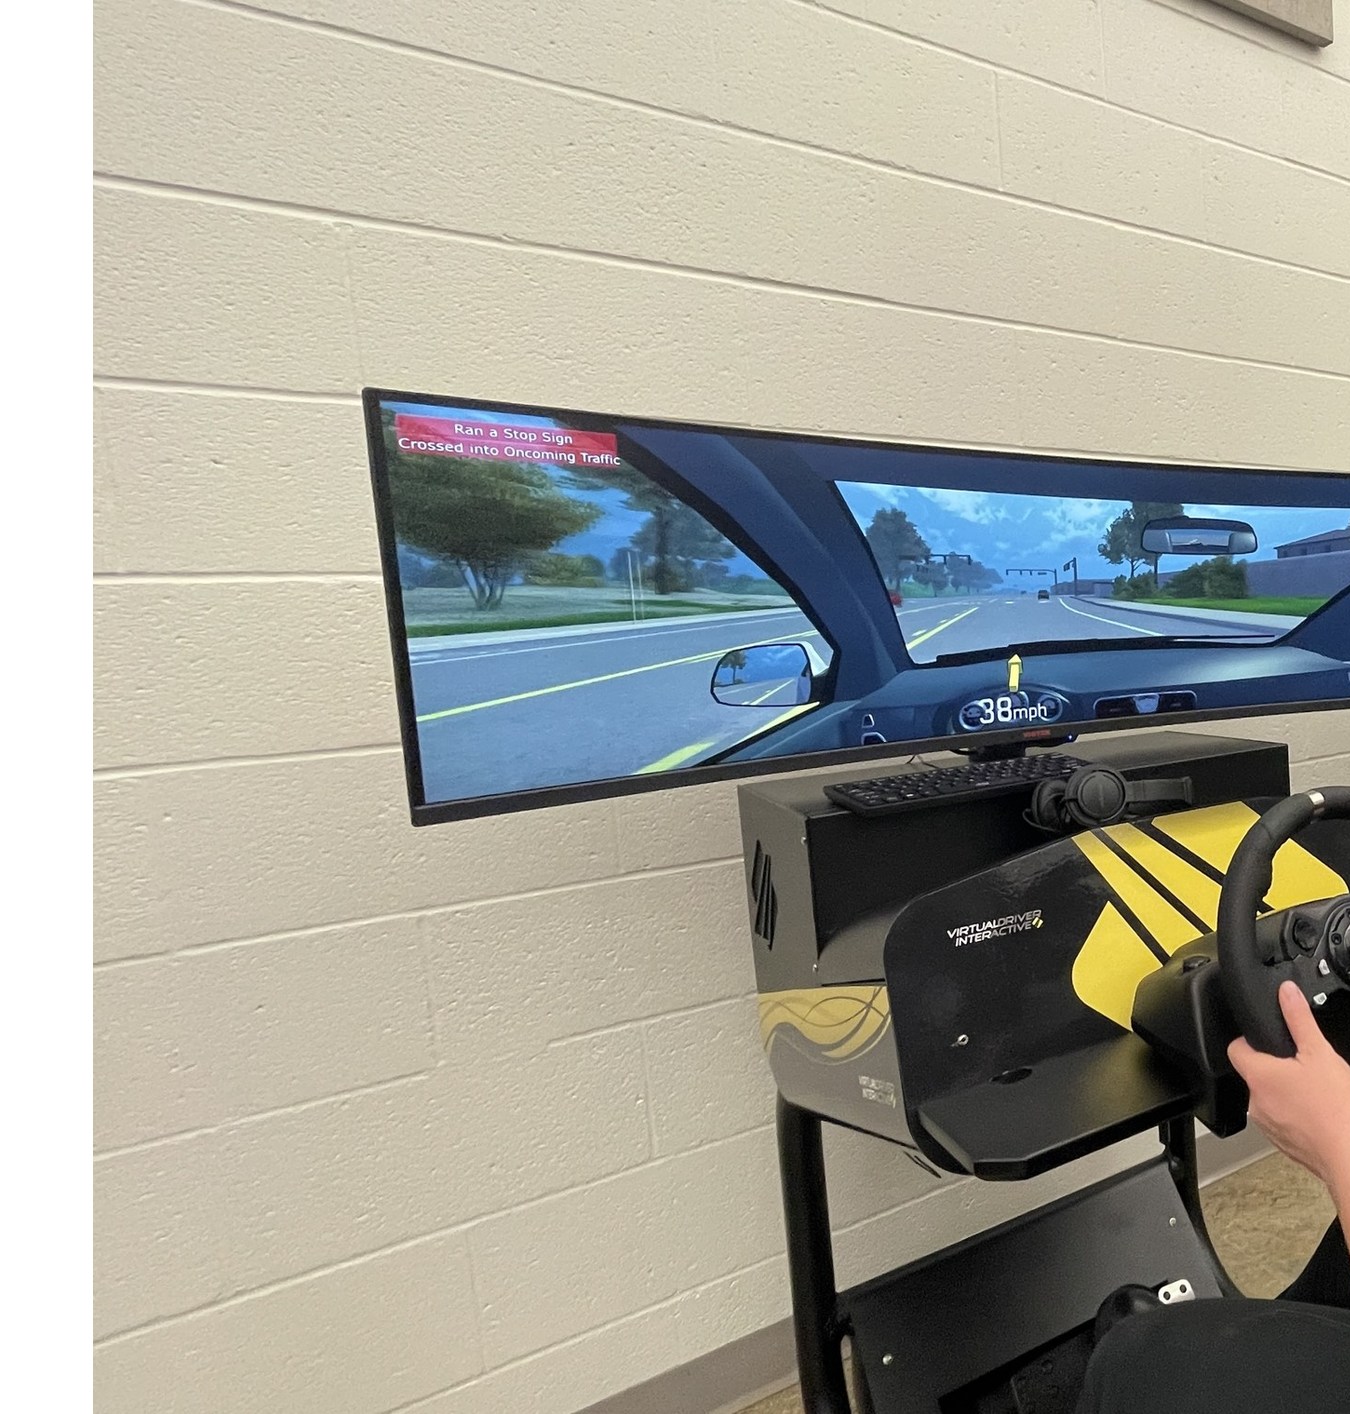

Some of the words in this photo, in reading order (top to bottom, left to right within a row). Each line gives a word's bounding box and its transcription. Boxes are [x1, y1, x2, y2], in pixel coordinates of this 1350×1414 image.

[454, 423, 484, 437] Ran
[489, 429, 498, 438] a
[503, 428, 537, 443] Stop
[542, 431, 573, 446] Sign
[398, 438, 463, 453] Crossed
[470, 444, 499, 456] into
[504, 446, 576, 464] Oncoming
[580, 452, 621, 466] Traffic
[955, 921, 1032, 947] INTERACTIVE
